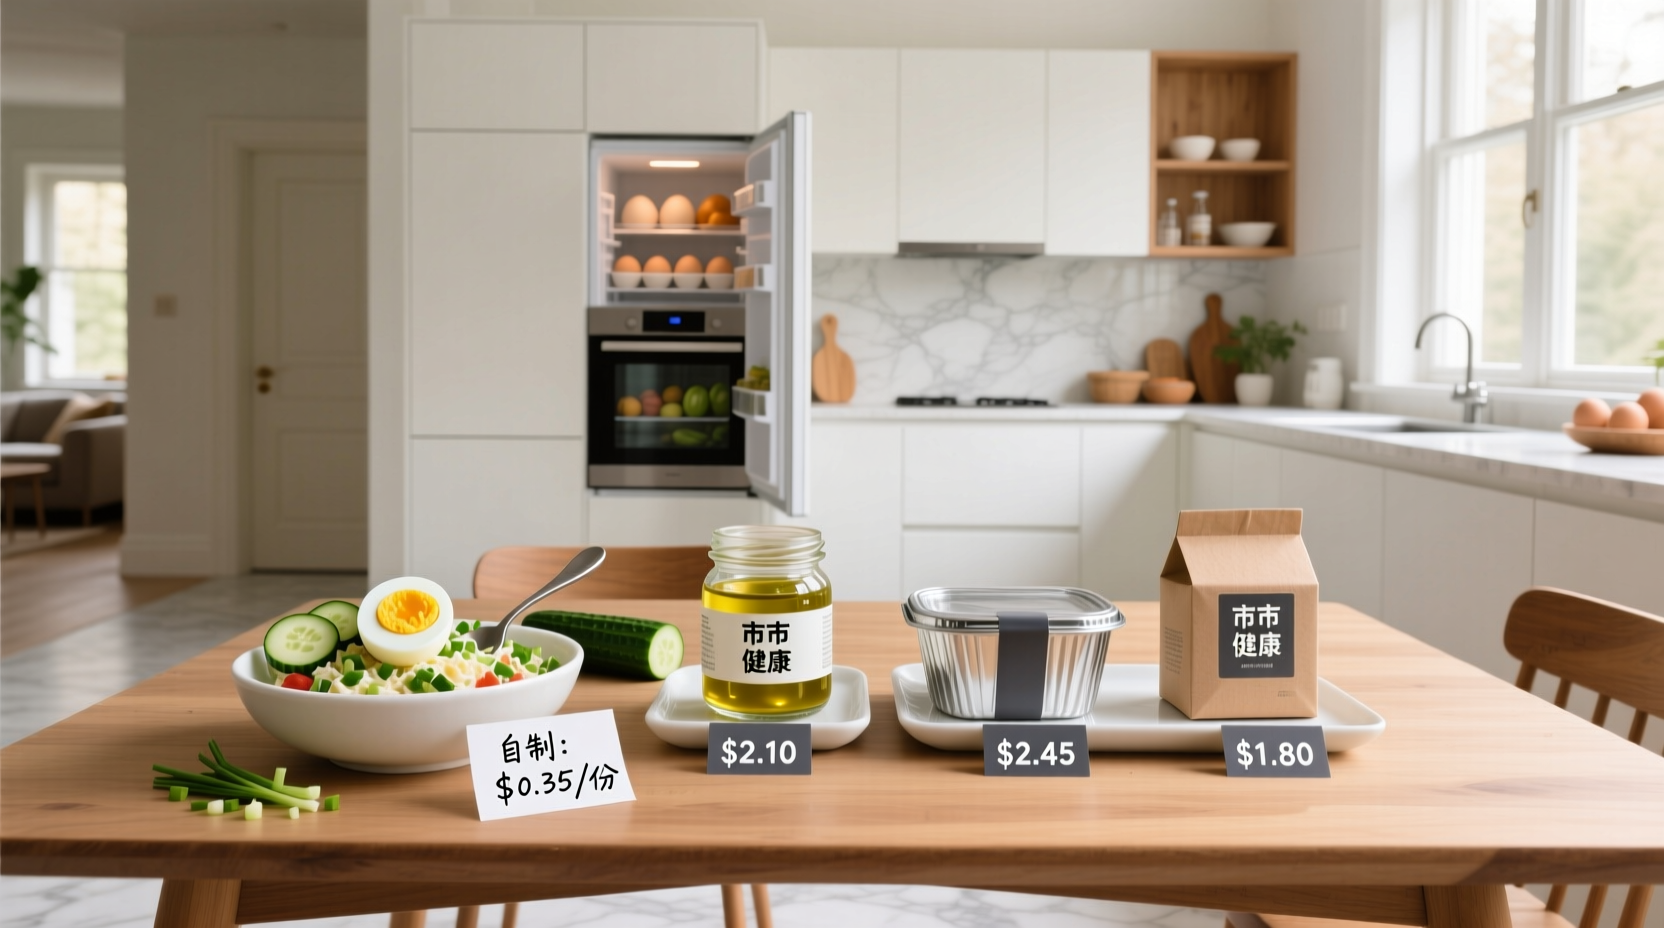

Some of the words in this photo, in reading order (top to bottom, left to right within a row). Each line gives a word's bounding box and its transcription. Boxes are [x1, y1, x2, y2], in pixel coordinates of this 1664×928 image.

[1232, 631, 1282, 658] 健康
[742, 648, 792, 674] 健康
[501, 730, 568, 763] 自制:
[720, 737, 797, 769] $2.10
[997, 737, 1076, 770] $2.45
[1236, 738, 1314, 770] $1.80
[496, 762, 619, 806] $0.35/份
